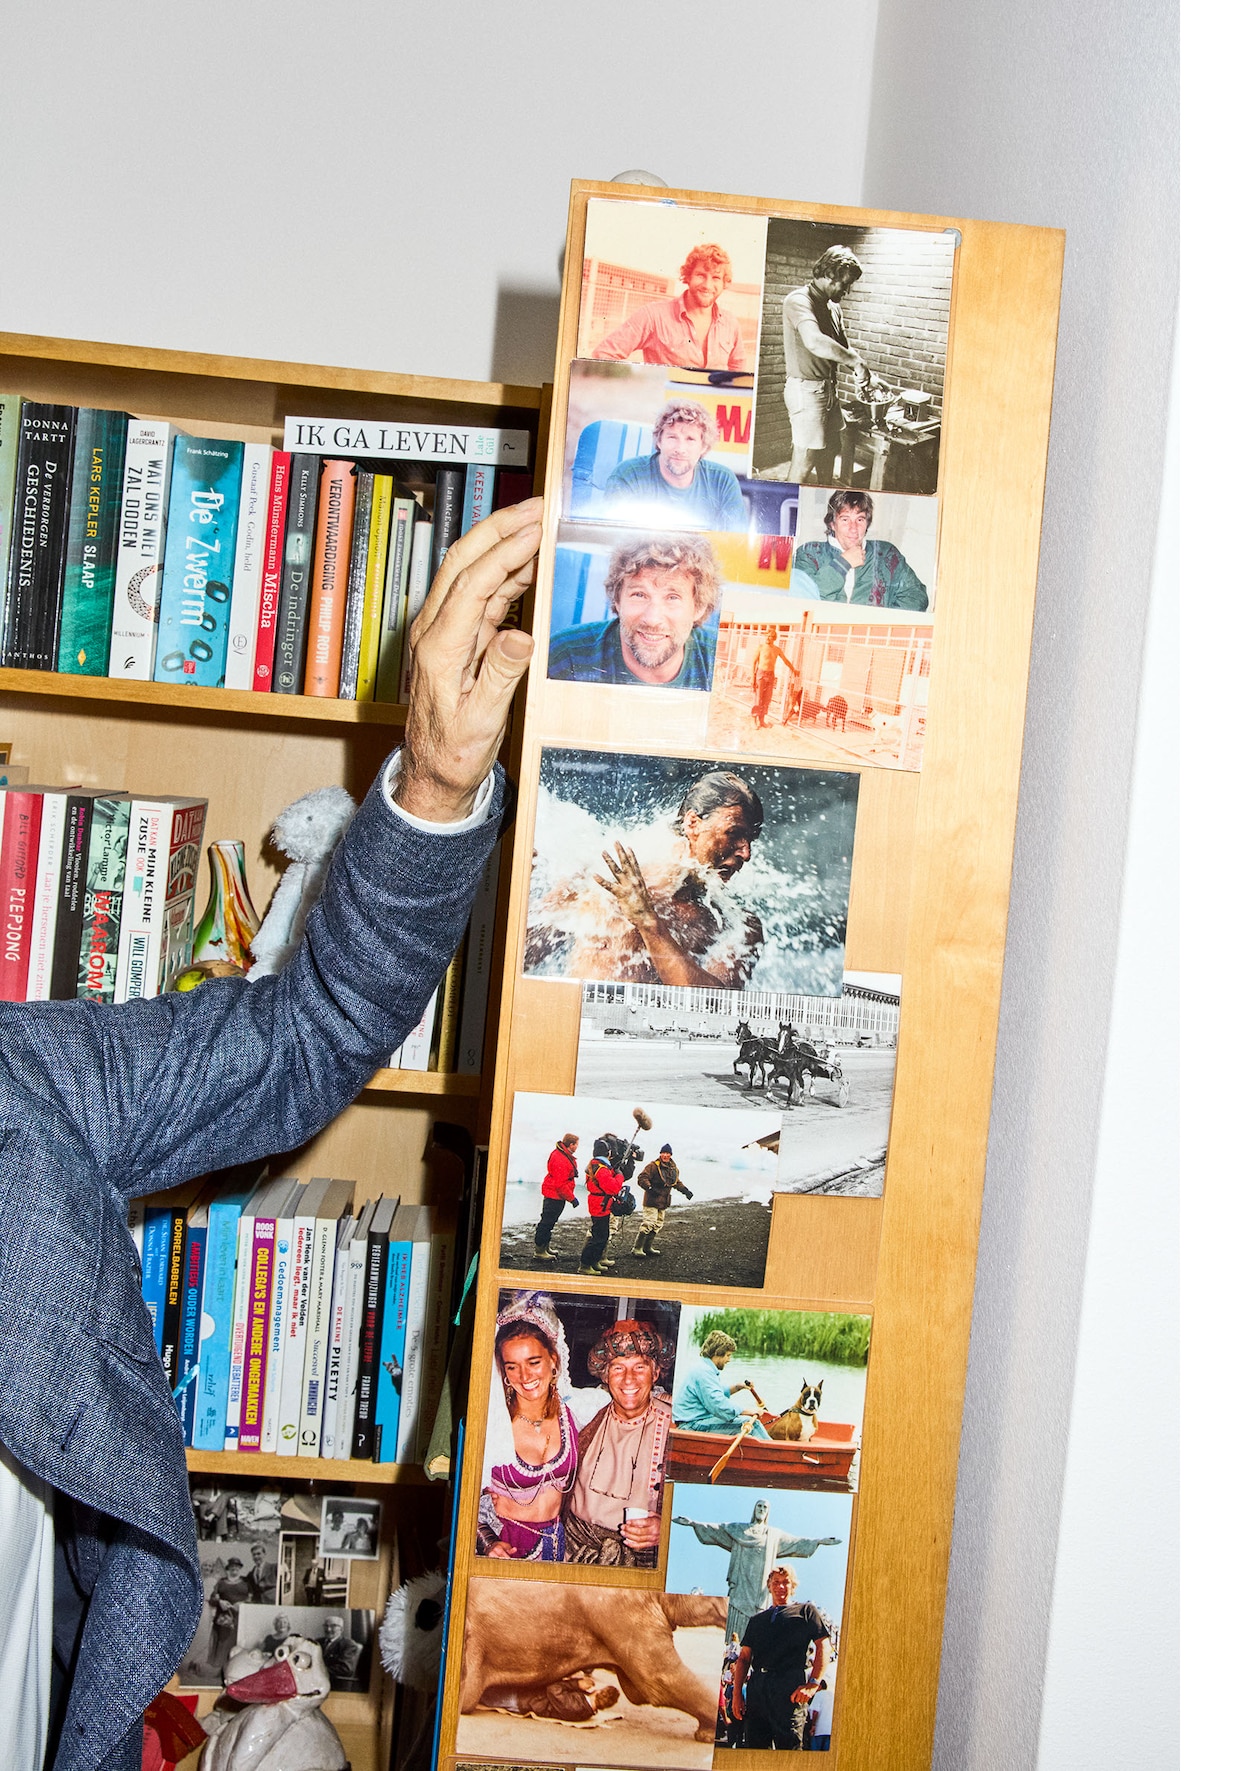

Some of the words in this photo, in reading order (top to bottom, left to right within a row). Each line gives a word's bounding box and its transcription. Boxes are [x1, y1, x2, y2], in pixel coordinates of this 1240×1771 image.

[24, 419, 69, 431] DONNA
[25, 431, 66, 442] TARTT
[294, 424, 326, 447] IK
[333, 427, 370, 450] GA
[379, 429, 470, 454] LEVEN
[202, 449, 228, 458] Schätzing
[475, 434, 485, 456] Lale
[485, 437, 495, 455] Gül
[45, 461, 57, 480] De
[91, 448, 103, 482] LARS
[148, 460, 163, 487] WAT
[249, 463, 260, 494] Gustaaf
[275, 466, 285, 492] Hans
[127, 468, 142, 493] ZAL
[473, 472, 484, 501] KEES
[40, 484, 52, 547] VERBORGEN
[86, 487, 101, 537] KEPLER
[144, 492, 161, 521] ONS
[190, 487, 224, 525] De
[248, 497, 257, 516] Peek
[444, 504, 453, 538] McEwan
[19, 465, 39, 586] GESCHIEDENIS
[123, 500, 140, 548] DODEN
[268, 495, 282, 569] Münstermann
[321, 479, 343, 590] VERONTWAARDIGING
[141, 529, 157, 559] NIET
[81, 546, 96, 589] SLAAP
[243, 553, 253, 571] held
[180, 537, 220, 626] Zwerm
[290, 571, 302, 590] De
[260, 573, 277, 628] Mischa
[319, 597, 333, 632] PHILIP
[281, 596, 300, 666] indringer
[7, 652, 49, 660] ANTHOS
[316, 636, 331, 663] ROTH
[19, 814, 29, 835] BILL
[50, 801, 58, 819] ERIK
[71, 816, 77, 825] de
[151, 818, 159, 830] DAT
[47, 824, 56, 866] SCHERDER
[65, 826, 76, 869] ontwikkeling
[138, 817, 148, 854] ZUSJE
[150, 832, 158, 845] KAN
[15, 841, 26, 879] GIFFORD
[101, 846, 111, 882] Lamme
[136, 858, 145, 872] OOK
[147, 849, 157, 877] MIJN
[45, 872, 54, 891] Laat
[71, 882, 79, 911] roddelen
[42, 895, 52, 903] je
[142, 881, 154, 923] KLEINE
[5, 888, 26, 961] PIEPJONG
[39, 906, 51, 949] hersenen
[87, 891, 111, 989] WAAROM
[132, 937, 145, 958] WILL
[38, 953, 47, 971] niet
[129, 960, 141, 1000] GOMPER
[295, 1228, 305, 1263] Iedereen
[169, 1218, 183, 1305] BORRELBABBELEN
[189, 1242, 200, 1287] AMBITIEUS
[254, 1248, 269, 1299] COLLEGA'S
[293, 1266, 302, 1286] liegt,
[367, 1244, 381, 1308] REGIEAANWIJZINGEN
[186, 1289, 196, 1317] OUDER
[253, 1302, 266, 1314] EN
[272, 1261, 287, 1352] Gedoemanagement
[299, 1299, 307, 1326] Velden
[337, 1307, 343, 1316] DE
[396, 1283, 406, 1330] ALZHEIMER
[365, 1331, 374, 1339] DE
[366, 1312, 375, 1328] VOOR
[184, 1319, 194, 1355] WORDEN
[233, 1322, 245, 1364] OVERTUIGEND
[250, 1318, 265, 1355] ANDERE
[411, 1330, 419, 1343] De
[163, 1345, 174, 1368] Hugo
[310, 1339, 321, 1376] Succesvol
[361, 1342, 373, 1363] LIEFDE
[407, 1354, 417, 1378] grote
[230, 1365, 242, 1402] DEBATTEREN
[328, 1347, 341, 1401] PIKETTY
[360, 1376, 369, 1398] FRANCA
[246, 1358, 260, 1425] ONGEMAKKEN
[405, 1380, 415, 1418] emoties
[359, 1401, 367, 1419] TREUR
